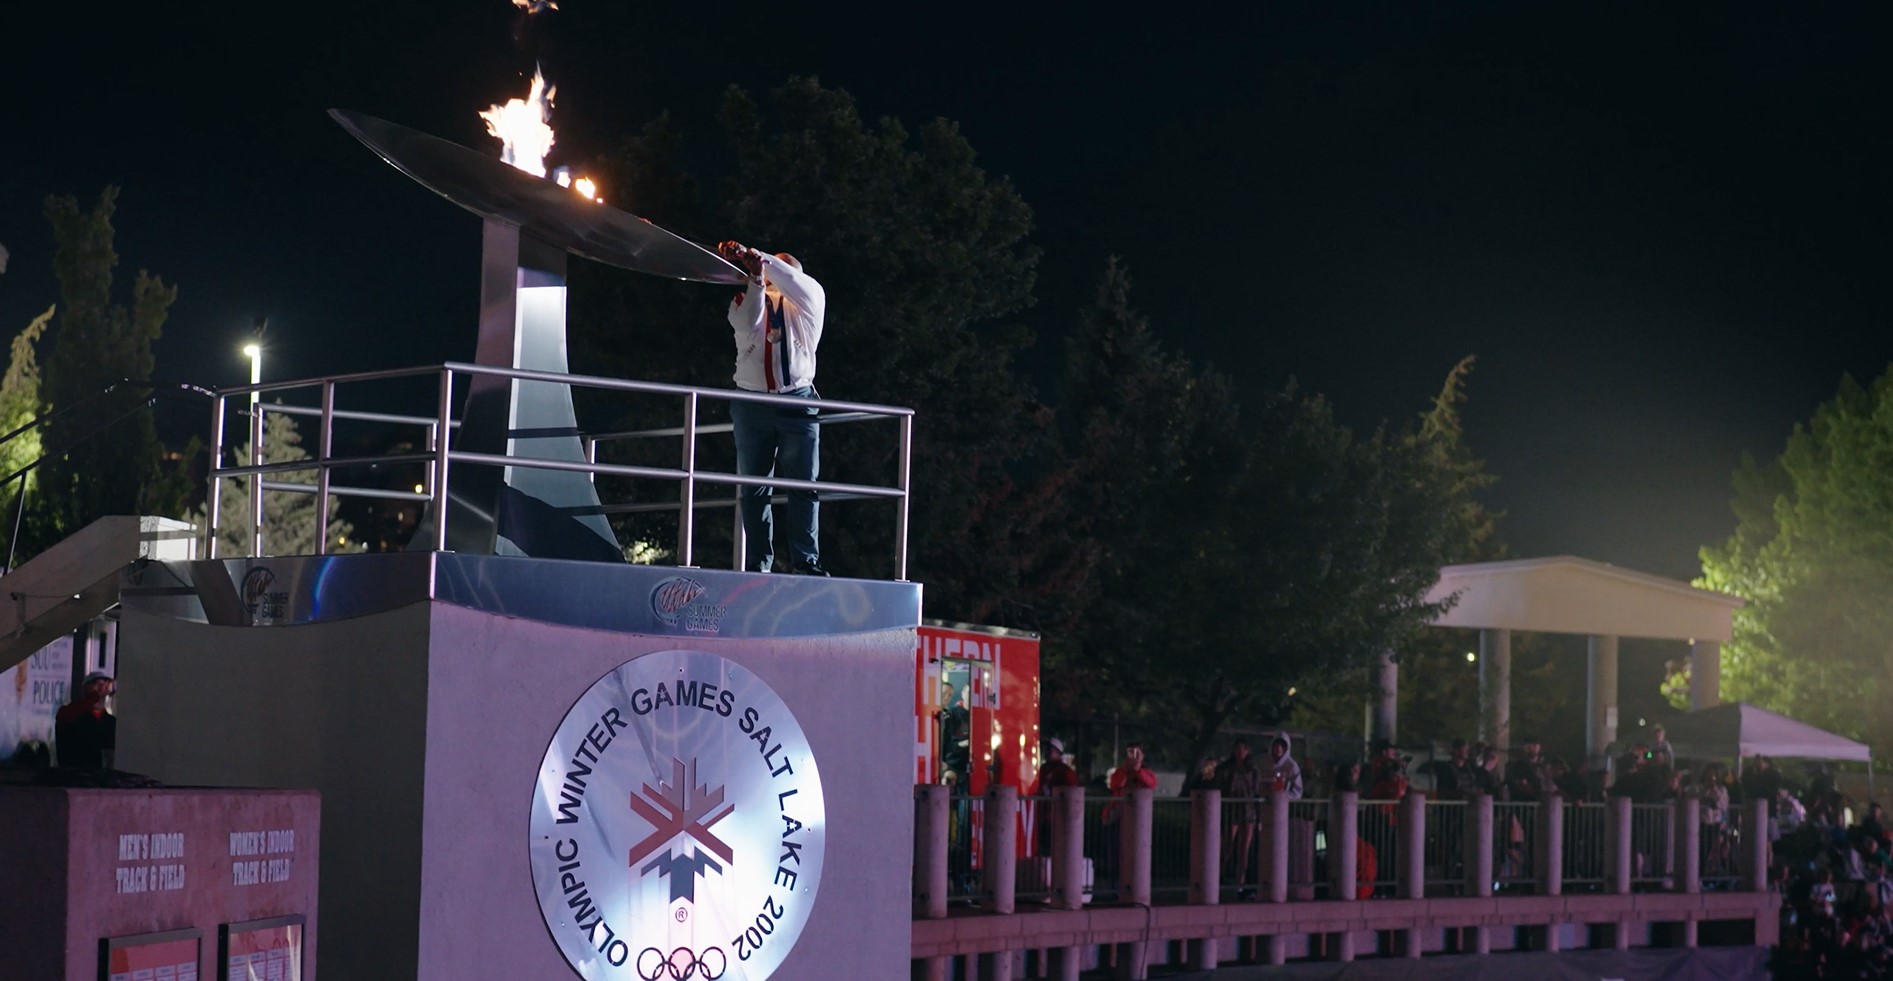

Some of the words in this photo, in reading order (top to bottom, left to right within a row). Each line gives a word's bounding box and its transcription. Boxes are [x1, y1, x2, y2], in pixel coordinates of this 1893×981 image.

[686, 618, 719, 631] GAMES
[687, 605, 727, 618] SUMMER
[33, 680, 65, 705] POLICE
[631, 679, 735, 717] GAMES
[738, 706, 794, 778] SALT
[556, 706, 628, 825] WINTER
[119, 834, 148, 860] MEN'S
[150, 832, 184, 859] INDOOR
[229, 831, 266, 856] WOMEN'S
[267, 829, 295, 853] INDOOR
[774, 788, 802, 891] LAKE
[116, 866, 148, 893] TRACK
[150, 865, 157, 891] &
[159, 864, 185, 890] FIELD
[233, 861, 259, 886] TRACK
[261, 860, 267, 883] &
[268, 858, 290, 882] FIELD
[555, 837, 629, 967] OLYMPIC
[731, 895, 784, 962] 2002
